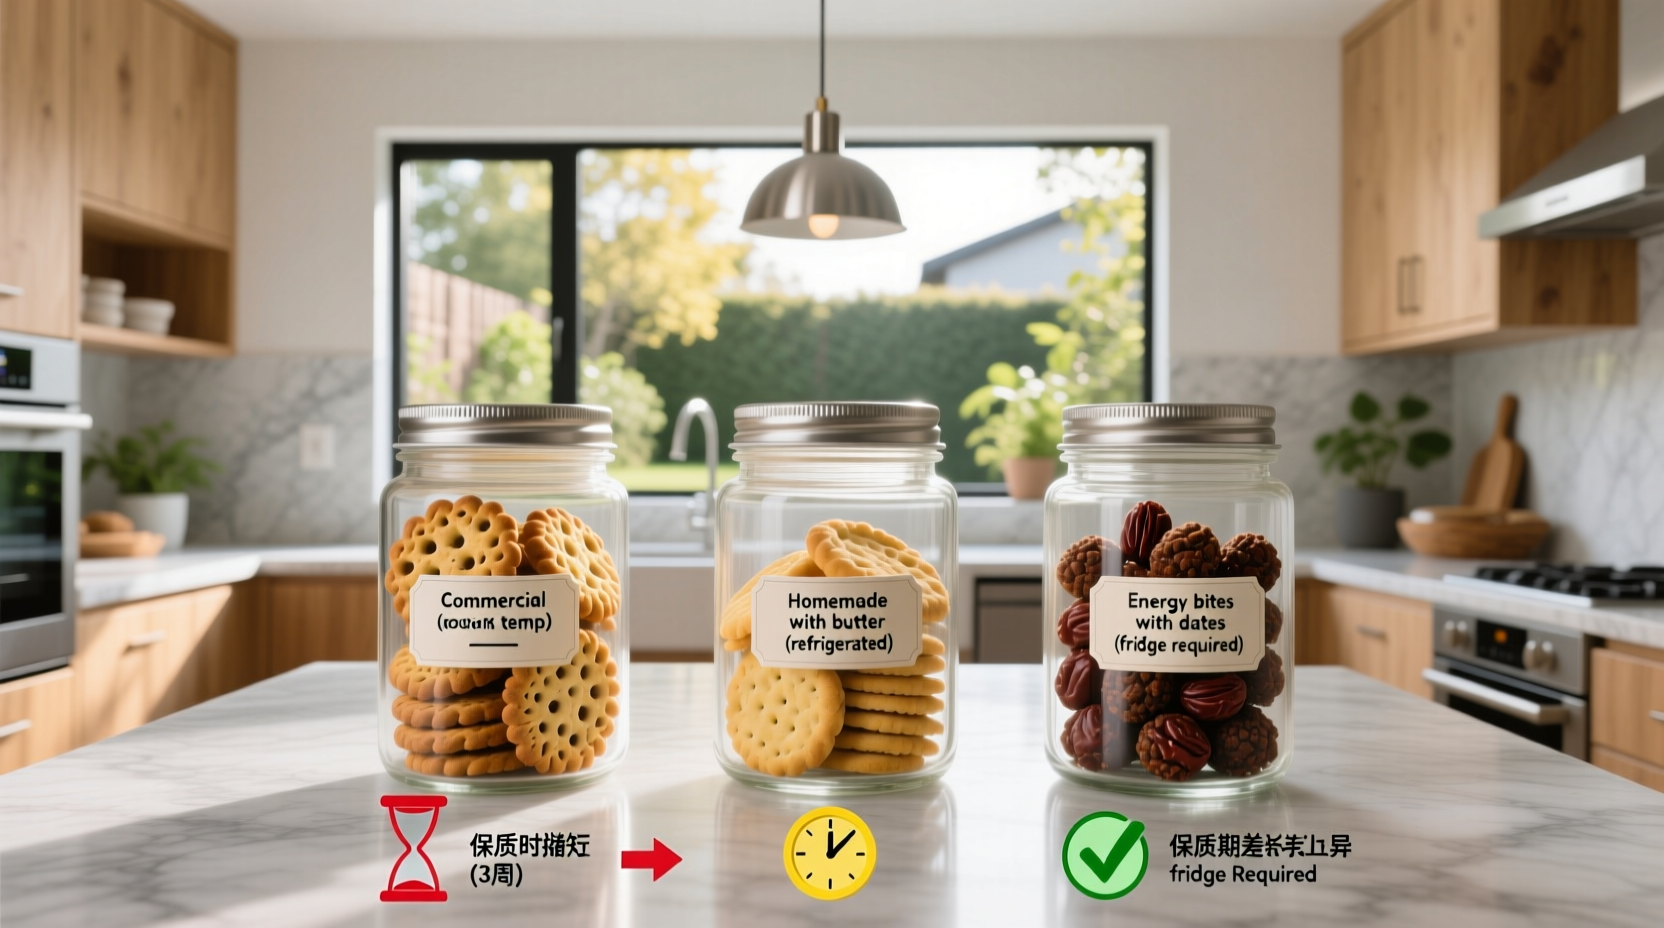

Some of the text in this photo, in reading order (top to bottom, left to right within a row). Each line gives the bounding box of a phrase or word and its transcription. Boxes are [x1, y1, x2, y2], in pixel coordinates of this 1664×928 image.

[441, 590, 546, 608] Commercial
[788, 591, 888, 609] Homemade
[1128, 592, 1235, 614] Energy bites
[501, 612, 552, 633] temp)
[789, 612, 886, 630] with butter
[1136, 614, 1226, 630] with dates
[785, 632, 893, 655] (refrigerated)
[1114, 634, 1244, 657] (fridge required)
